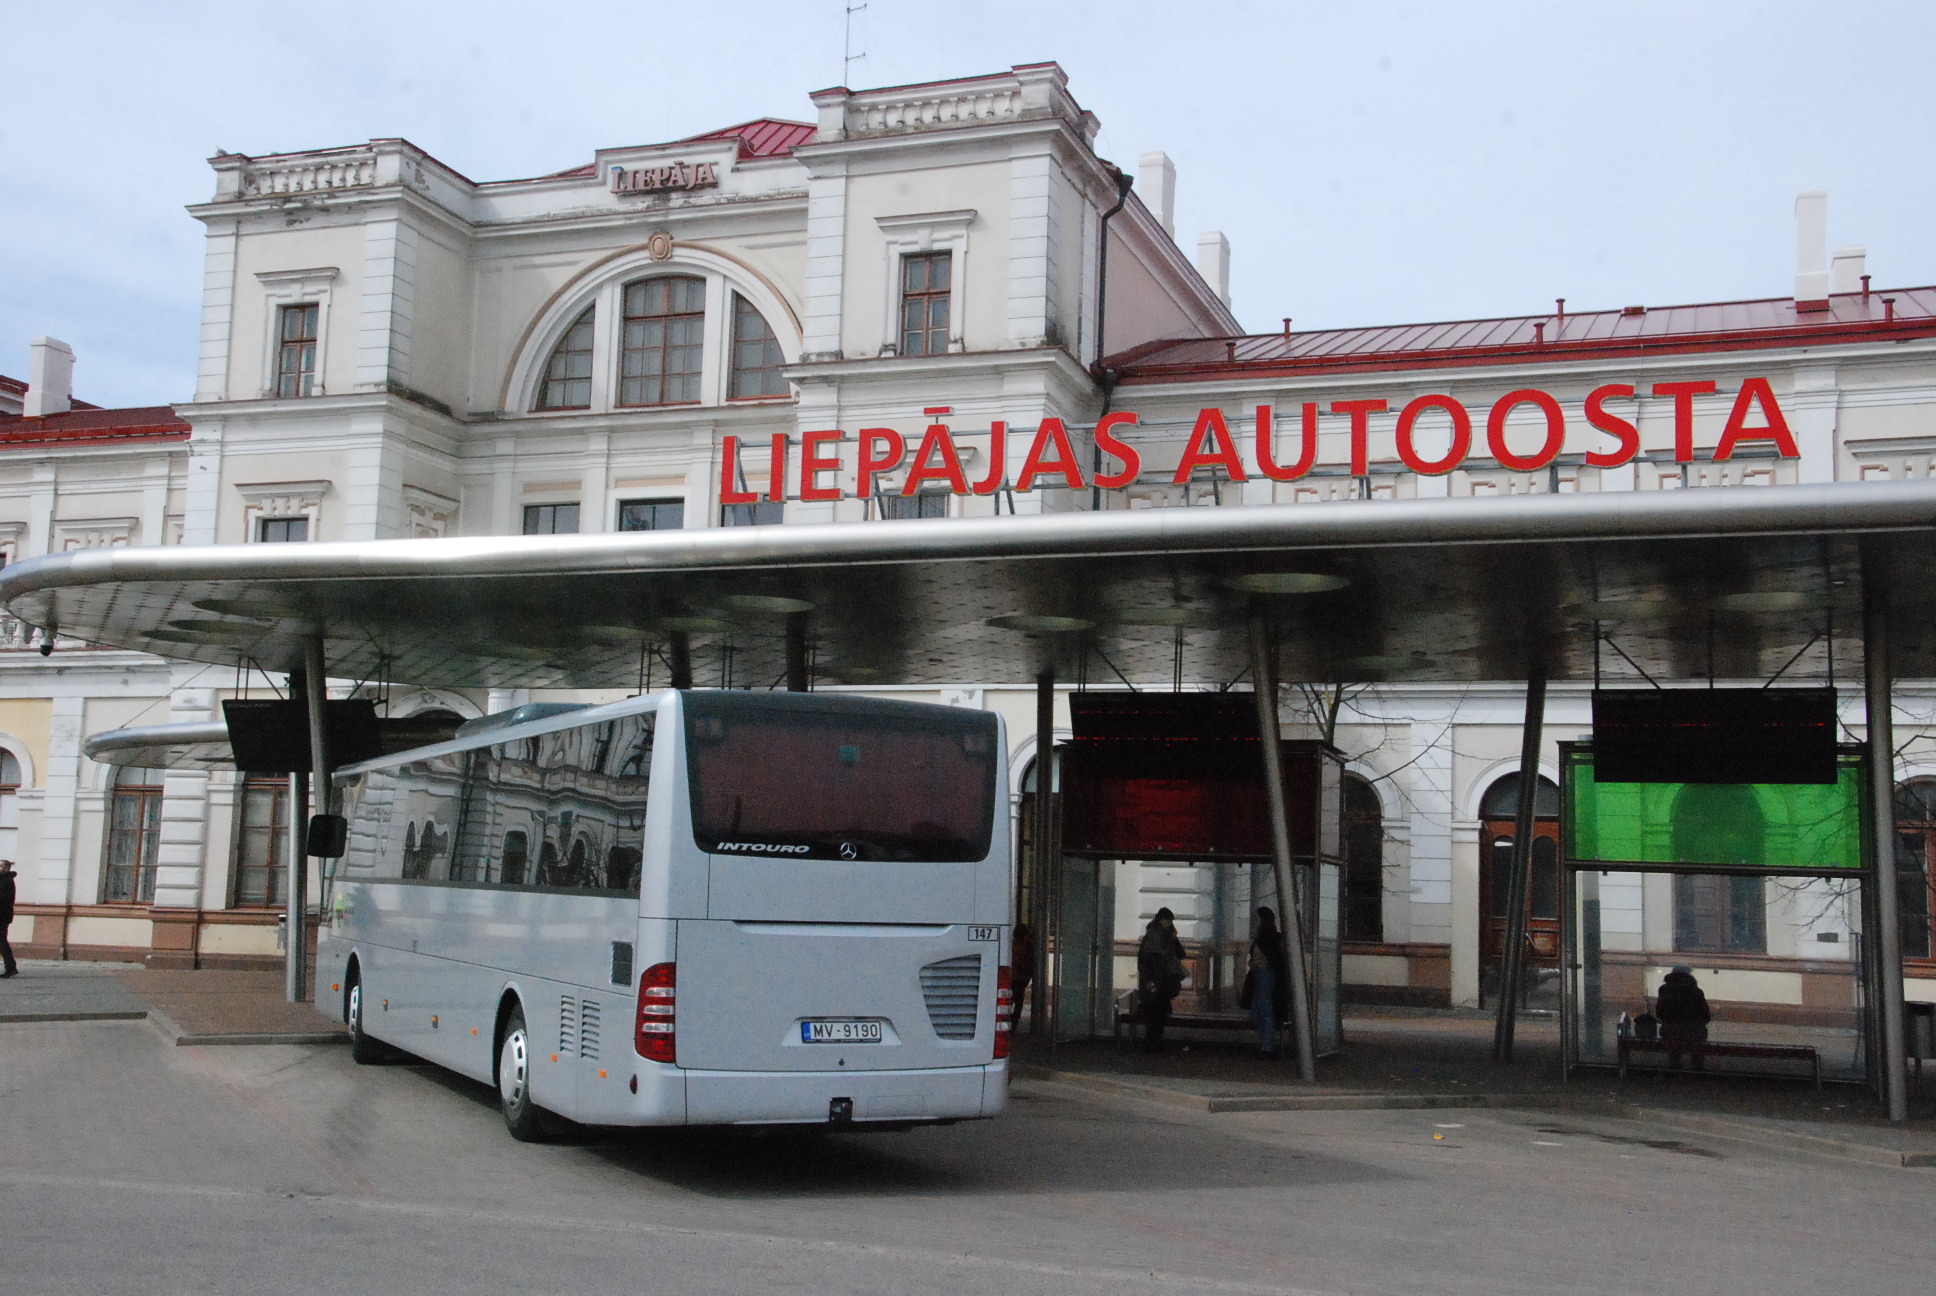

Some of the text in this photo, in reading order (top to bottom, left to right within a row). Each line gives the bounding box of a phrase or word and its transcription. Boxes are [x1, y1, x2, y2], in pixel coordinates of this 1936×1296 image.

[611, 161, 718, 194] LIEPĀJA
[720, 377, 1802, 504] LIEPĀJAS AUTOOSTA
[717, 842, 810, 853] INTOURO
[974, 928, 992, 939] 147
[814, 1024, 878, 1038] MV-9190
